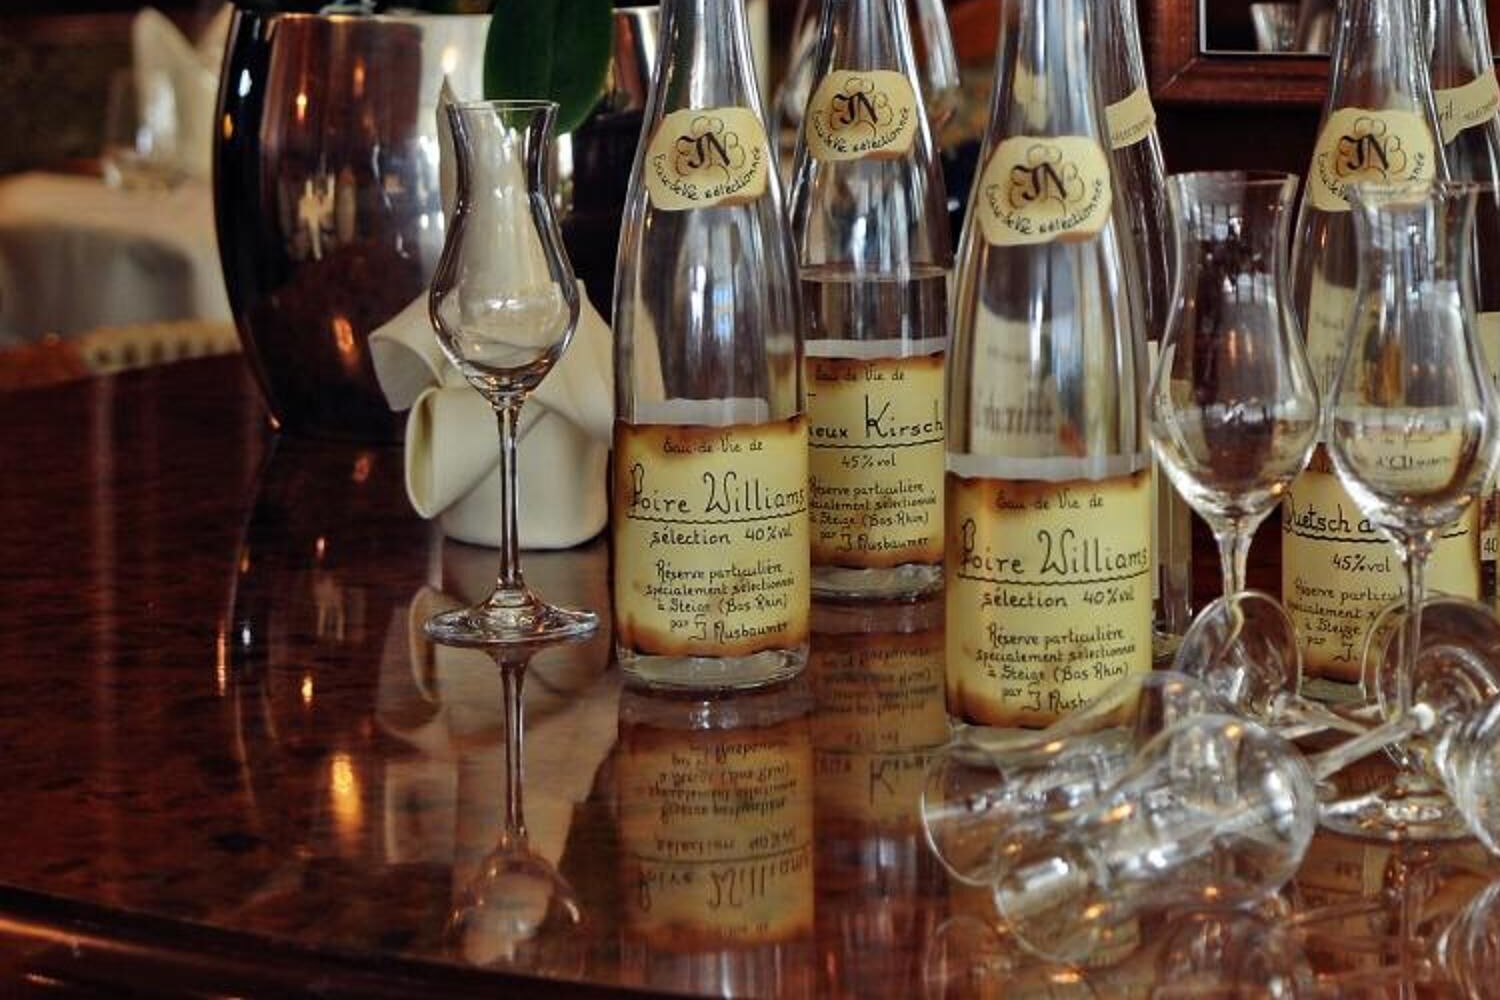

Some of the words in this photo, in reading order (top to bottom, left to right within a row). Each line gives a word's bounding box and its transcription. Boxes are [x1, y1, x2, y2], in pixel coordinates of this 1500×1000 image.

[864, 393, 945, 439] Kirsch
[720, 431, 744, 453] Vie
[750, 438, 764, 452] de
[629, 463, 691, 514] Poire
[703, 471, 806, 515] Williams
[1058, 488, 1081, 510] Vie
[1089, 493, 1105, 509] de
[649, 525, 732, 548] sélection
[961, 517, 1025, 574] Poire
[1037, 528, 1148, 576] Williams
[656, 559, 705, 583] Réserve
[981, 587, 1069, 610] sélection
[986, 622, 1041, 648] Réserve
